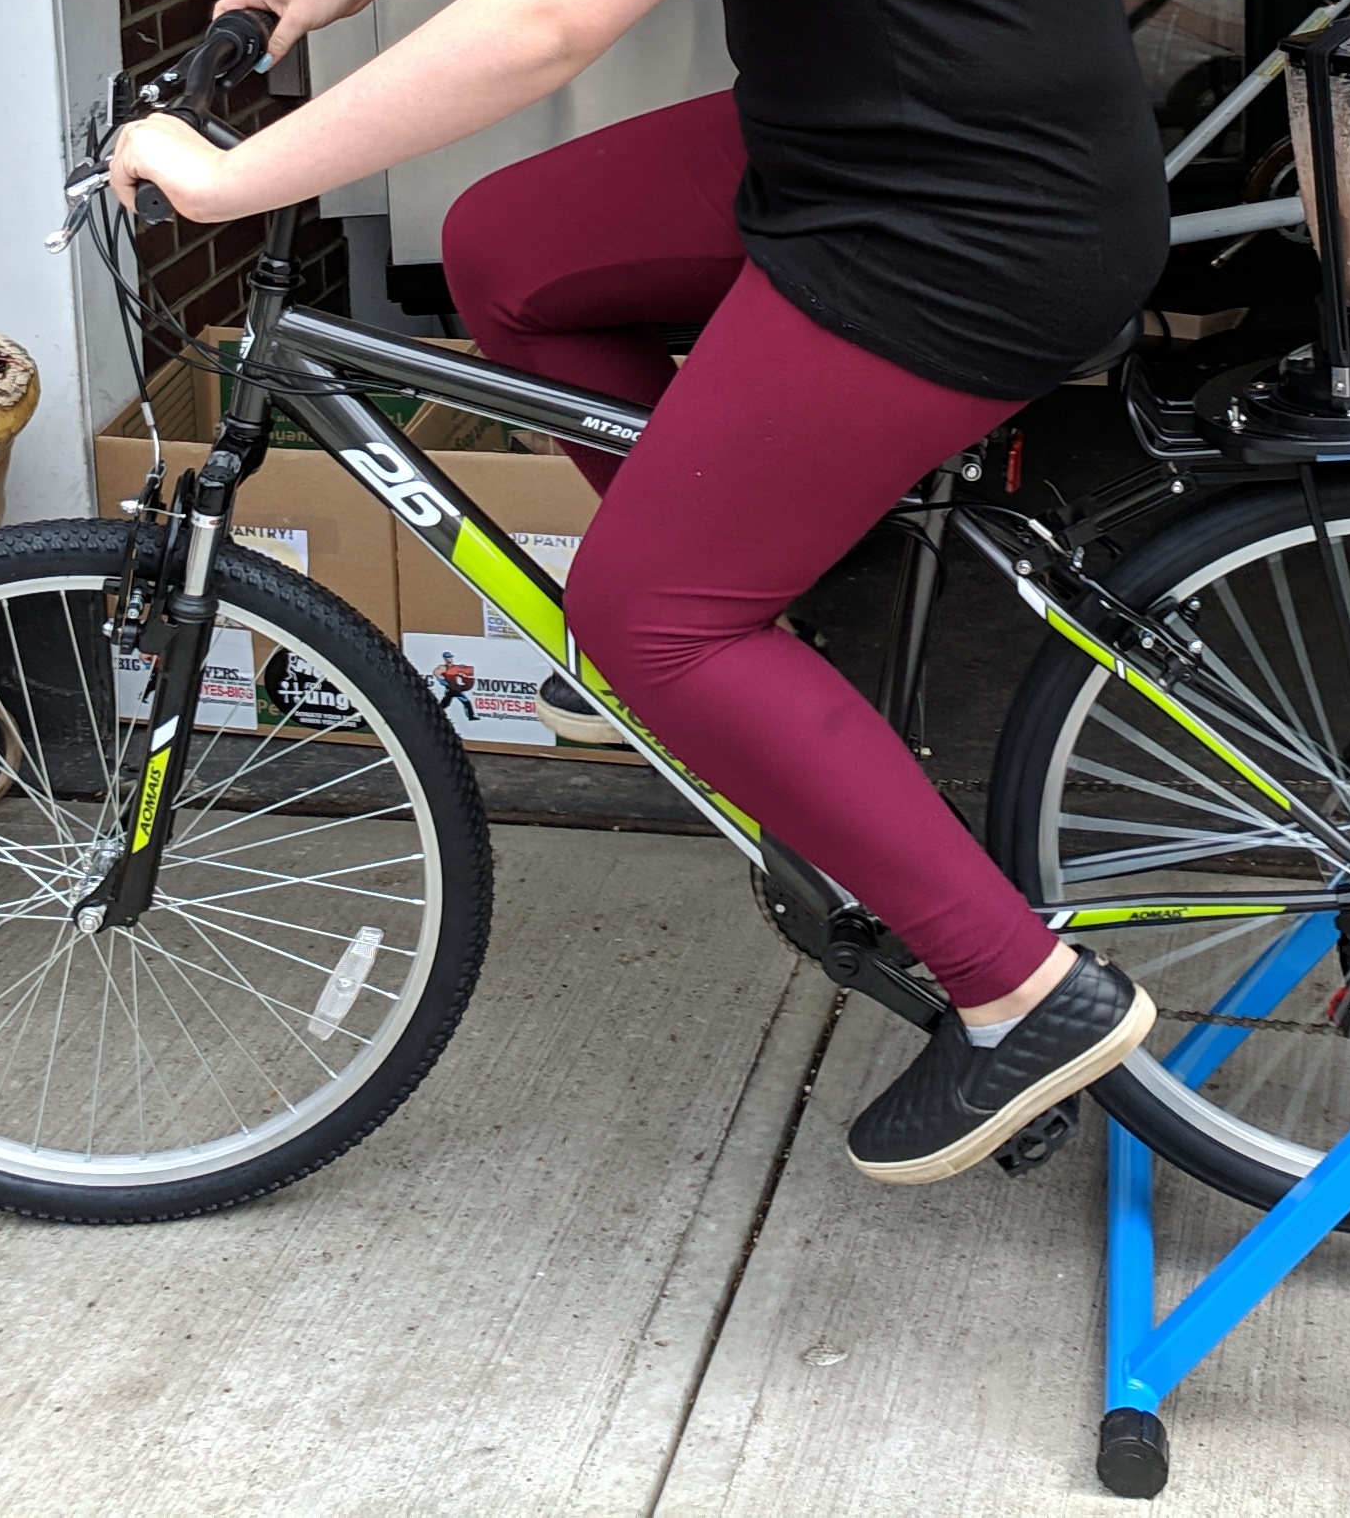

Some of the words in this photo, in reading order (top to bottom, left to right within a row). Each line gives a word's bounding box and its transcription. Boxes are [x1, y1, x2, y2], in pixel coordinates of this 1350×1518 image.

[339, 442, 461, 527] 26
[231, 526, 294, 540] ANTRY!
[534, 535, 583, 548] PANT
[477, 679, 538, 695] MOVERS
[138, 766, 163, 836] AOMAIS
